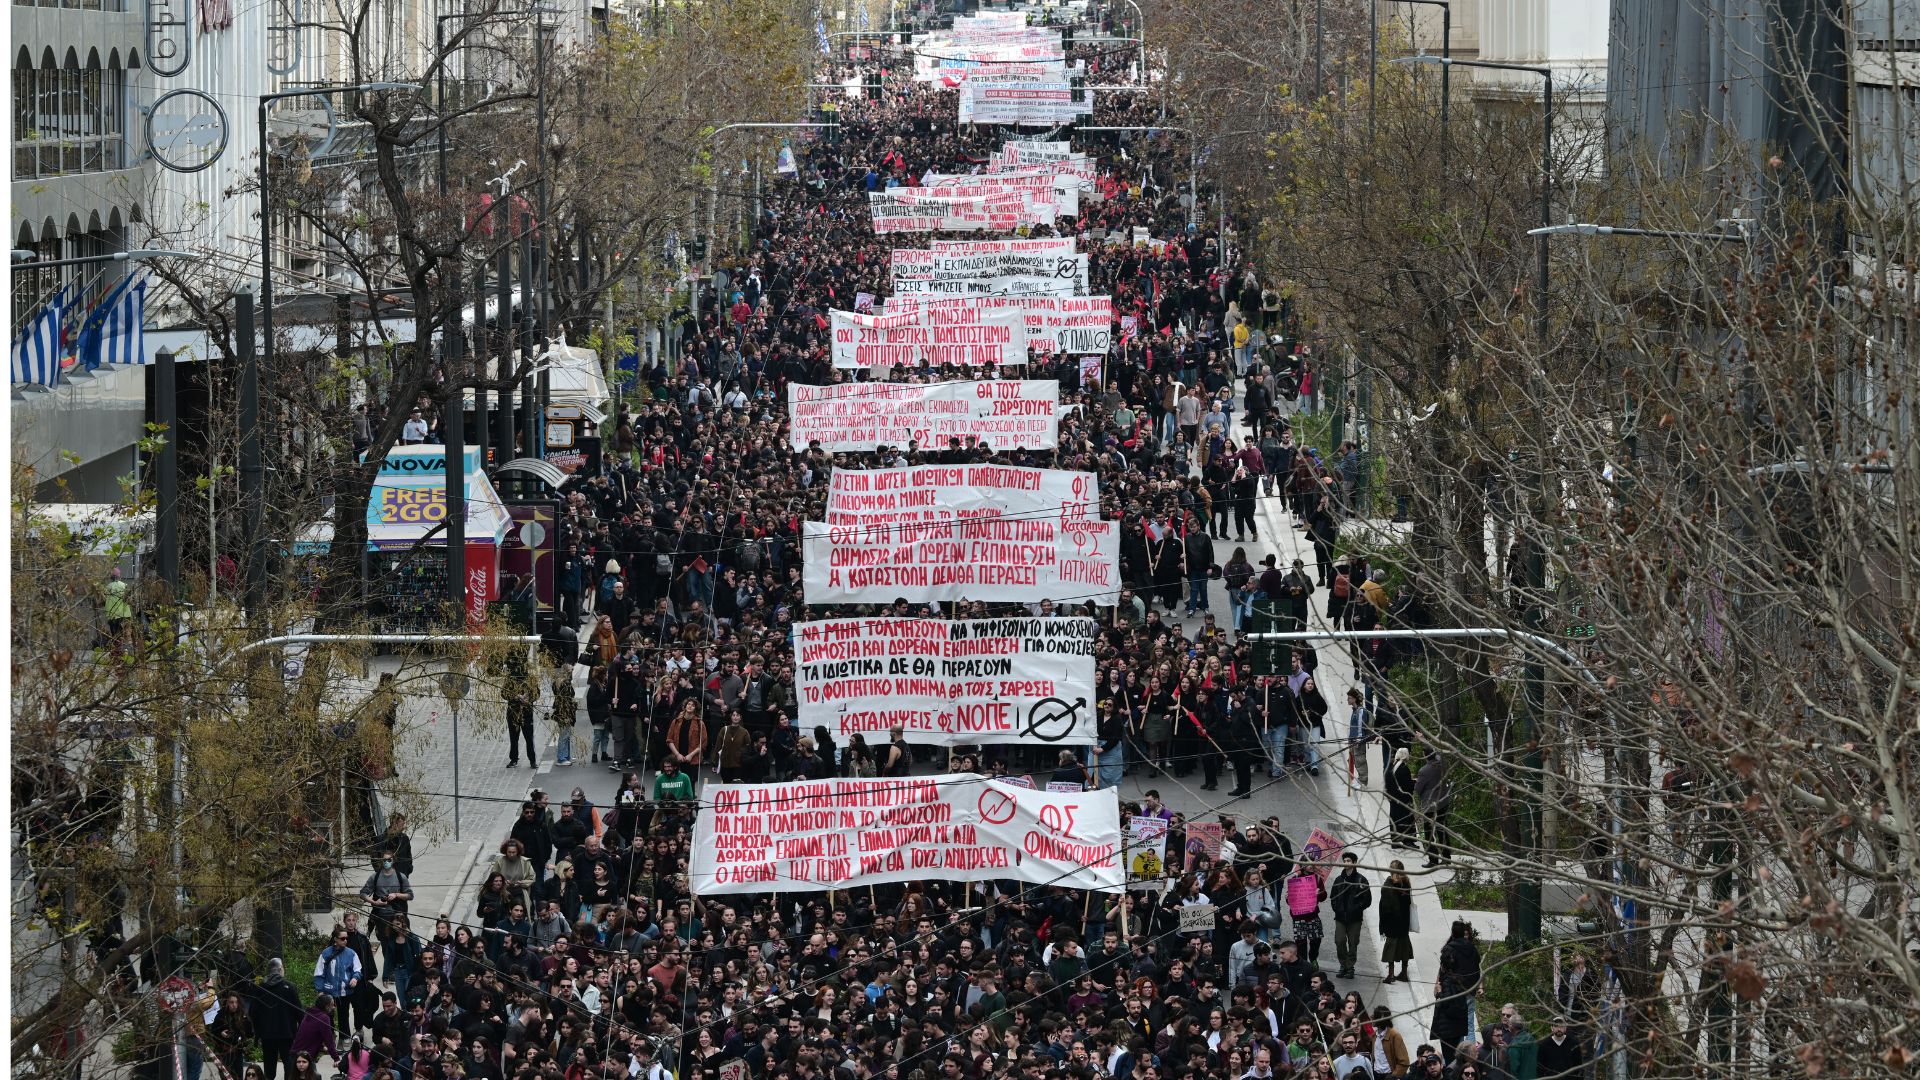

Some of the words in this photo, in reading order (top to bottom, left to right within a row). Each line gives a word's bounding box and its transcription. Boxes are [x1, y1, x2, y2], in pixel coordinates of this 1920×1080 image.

[896, 281, 922, 292] ΕΣΕΙΣ
[928, 282, 962, 292] ΨΗΦΙΖΕΤΕ
[902, 298, 919, 312] ΣΤΑ
[853, 315, 862, 325] ΟΙ
[873, 312, 920, 330] ΦΟΙΤΗΤΕΣ
[836, 328, 852, 342] ΟΧΙ
[858, 328, 878, 342] ΣΤΑ
[886, 328, 928, 344] ΙΔΙΩΤΙΚΑ
[933, 326, 1010, 344] ΠΑΝΕΠΙΣΤΗΜΙΑ
[797, 386, 814, 400] ΟΧΙ
[820, 386, 832, 400] ΣΤΑ
[838, 384, 869, 400] ΙΔΙΩΤΙΚΑ
[976, 383, 992, 398] ΘΑ
[996, 382, 1022, 399] ΤΟΥΣ
[796, 402, 848, 416] ΑΠΟΚΛΕΙΣΤΙΚΑ
[928, 400, 968, 414] ΕΚΠΑΙΔΕΥΣΗ
[992, 400, 1054, 416] ΣΑΡΩΣΟΥΜΕ
[796, 418, 809, 428] ΟΧΙ
[812, 416, 834, 428] ΣΤΗΝ
[924, 416, 932, 427] 16
[960, 420, 967, 432] ΤΟ
[1016, 420, 1026, 432] ΘΑ
[796, 431, 800, 442] Η
[852, 429, 866, 442] ΔΕΝ
[994, 435, 1008, 446] ΣΤΗ
[1012, 434, 1040, 448] ΦΩΤΙΑ
[382, 458, 446, 472] NOVA
[844, 474, 869, 492] ΣΤΗΝ
[874, 472, 907, 490] ΙΔΡΥΣΗ
[912, 468, 963, 486] ΙΔΙΩΤΙΚΩΝ
[968, 467, 1042, 490] ΠΑΝΕΠΙΣΤΗΜΙΩΝ
[382, 487, 446, 504] FREE
[836, 492, 896, 511] ΠΛΕΙΟΨΗΦΙΑ
[900, 490, 936, 508] ΜΙΛΗΣΕ
[382, 503, 448, 522] 2GO
[840, 512, 858, 526] ΜΗΝ
[830, 526, 858, 545] ΟΧΙ
[864, 523, 891, 545] ΣΤΑ
[900, 520, 952, 543] ΙΔΙΩΤΙΚΑ
[960, 519, 1054, 542] ΠΑΝΕΠΙΣΤΗΜΙΑ
[1061, 520, 1110, 535] Κατάληψη
[830, 548, 891, 568] ΔΗΜΟΣΙΑ
[894, 545, 914, 565] ΚΑΙ
[920, 542, 966, 564] ΔΩΡΕΑΝ
[970, 541, 1056, 566] ΕΚΠΑΙΔΕΥΣΗ
[828, 568, 840, 588] Η
[848, 566, 928, 588] ΚΑΤΑΣΤΟΛΗ
[932, 566, 956, 586] ΔΕΝ
[956, 565, 974, 584] ΘΑ
[979, 565, 1036, 586] ΠΕΡΑΣΕΙ
[1059, 560, 1111, 587] ΙΑΤΡΙΚΗΣ
[802, 625, 821, 642] ΝΑ
[824, 621, 861, 642] ΜΗΝ
[865, 620, 948, 640] ΤΟΛΜΗΣΟΥΝ
[950, 623, 968, 641] ΝΑ
[1044, 619, 1094, 639] ΝΟΜΟΣΧΕΔΙΟ
[802, 640, 860, 662] ΔΗΜΟΣΙΑ
[862, 640, 884, 657] ΚΑΙ
[888, 638, 940, 658] ΔΩΡΕΑΝ
[944, 638, 1020, 658] ΕΚΠΑΙΔΕΥΣΗ
[1024, 638, 1044, 653] ΓΙΑ
[802, 664, 819, 681] ΤΑ
[822, 659, 883, 678] ΙΔΙΩΤΙΚΑ
[889, 658, 910, 675] ΔΕ
[912, 658, 935, 678] ΘΑ
[942, 658, 1012, 678] ΠΕΡΑΣΟΥΝ
[804, 686, 820, 704] ΤΟ
[822, 678, 893, 700] ΦΟΙΤΗΤΙΚΟ
[896, 677, 947, 699] ΚΙΝΗΜΑ
[949, 684, 963, 699] ΘΑ
[965, 681, 994, 697] ΤΟΥΣ
[999, 680, 1055, 697] ΣΑΡΩΣΕΙ
[840, 710, 933, 736] ΚΑΤΑΛΗΨΕΙΣ
[937, 712, 954, 734] ΦΣ
[956, 702, 1012, 732] ΝΟΠΕ
[714, 790, 740, 814] ΟΧΙ
[748, 788, 772, 814] ΣΤΑ
[776, 784, 833, 812] ΙΔΙΩΤΙΚΑ
[836, 780, 939, 808] ΠΑΝΕΠΙΣΤΗΜΙΑ
[714, 814, 731, 834] ΝΑ
[734, 815, 762, 834] ΜΗΝ
[768, 810, 836, 834] ΤΟΛΜΗΣΟΥΝ
[840, 810, 856, 828] ΝΑ
[859, 810, 874, 826] ΤΟ
[880, 802, 950, 828] ΨΗΦΙΣΟΥΝ
[715, 834, 774, 848] ΔΗΜΟΣΙΑ
[776, 833, 848, 860] ΕΚΠΑΙΔΕΥΣΗ
[858, 828, 894, 852] ΕΝΙΑΙΑ
[896, 824, 931, 848] ΠΤΥΧΙΑ
[935, 824, 950, 844] ΜΕ
[954, 824, 977, 845] ΑΞΙΑ
[1024, 830, 1117, 869] ΦΙΛΟΣΟΦΙΚΗΣ
[716, 848, 766, 863] ΔΩΡΕΑΝ
[716, 866, 728, 884] Ο
[731, 862, 778, 884] ΑΓΩΝΑΣ
[788, 858, 811, 882] ΤΗΣ
[816, 857, 853, 882] ΓΕΝΙΑΣ
[860, 853, 884, 876] ΜΑΣ
[886, 851, 905, 872] ΘΑ
[911, 848, 940, 869] ΤΟΥΣ
[944, 847, 1009, 871] ΑΝΑΤΡΕΨΕΙ
